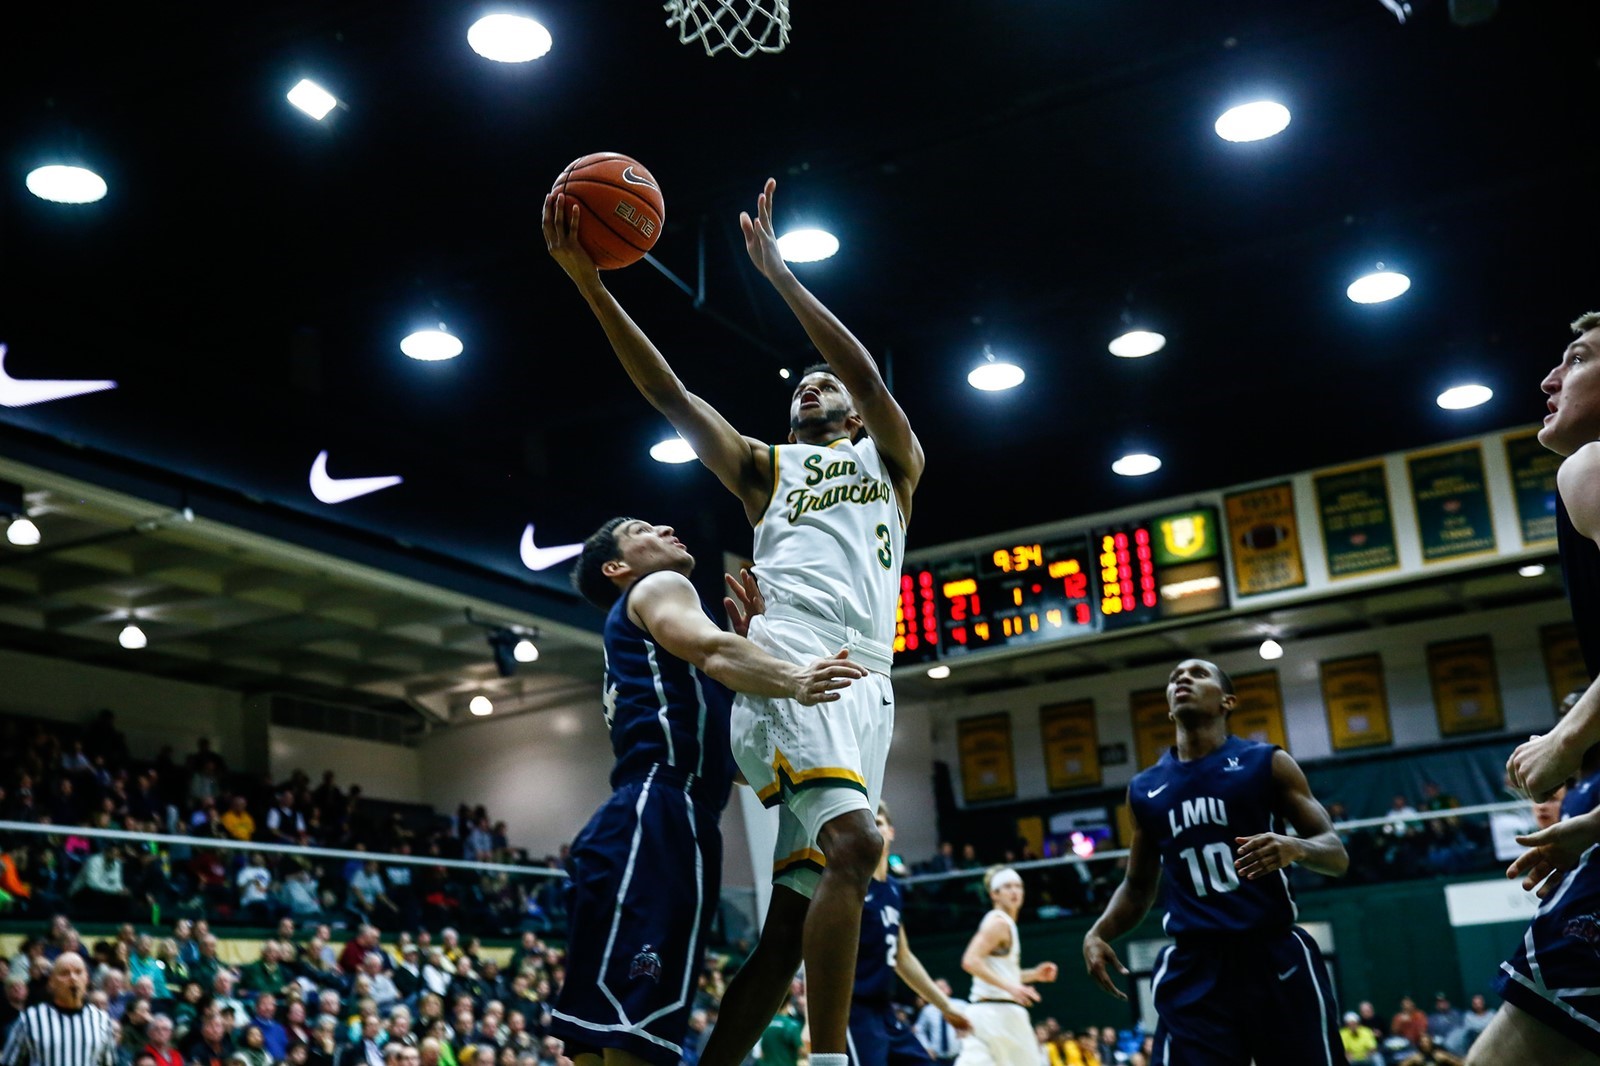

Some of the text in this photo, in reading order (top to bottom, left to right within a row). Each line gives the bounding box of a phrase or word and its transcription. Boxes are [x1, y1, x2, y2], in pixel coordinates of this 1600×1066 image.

[614, 200, 656, 239] ELITE
[803, 454, 857, 486] San
[875, 523, 892, 571] 3
[1168, 797, 1228, 838] LMU
[1179, 842, 1240, 897] 10
